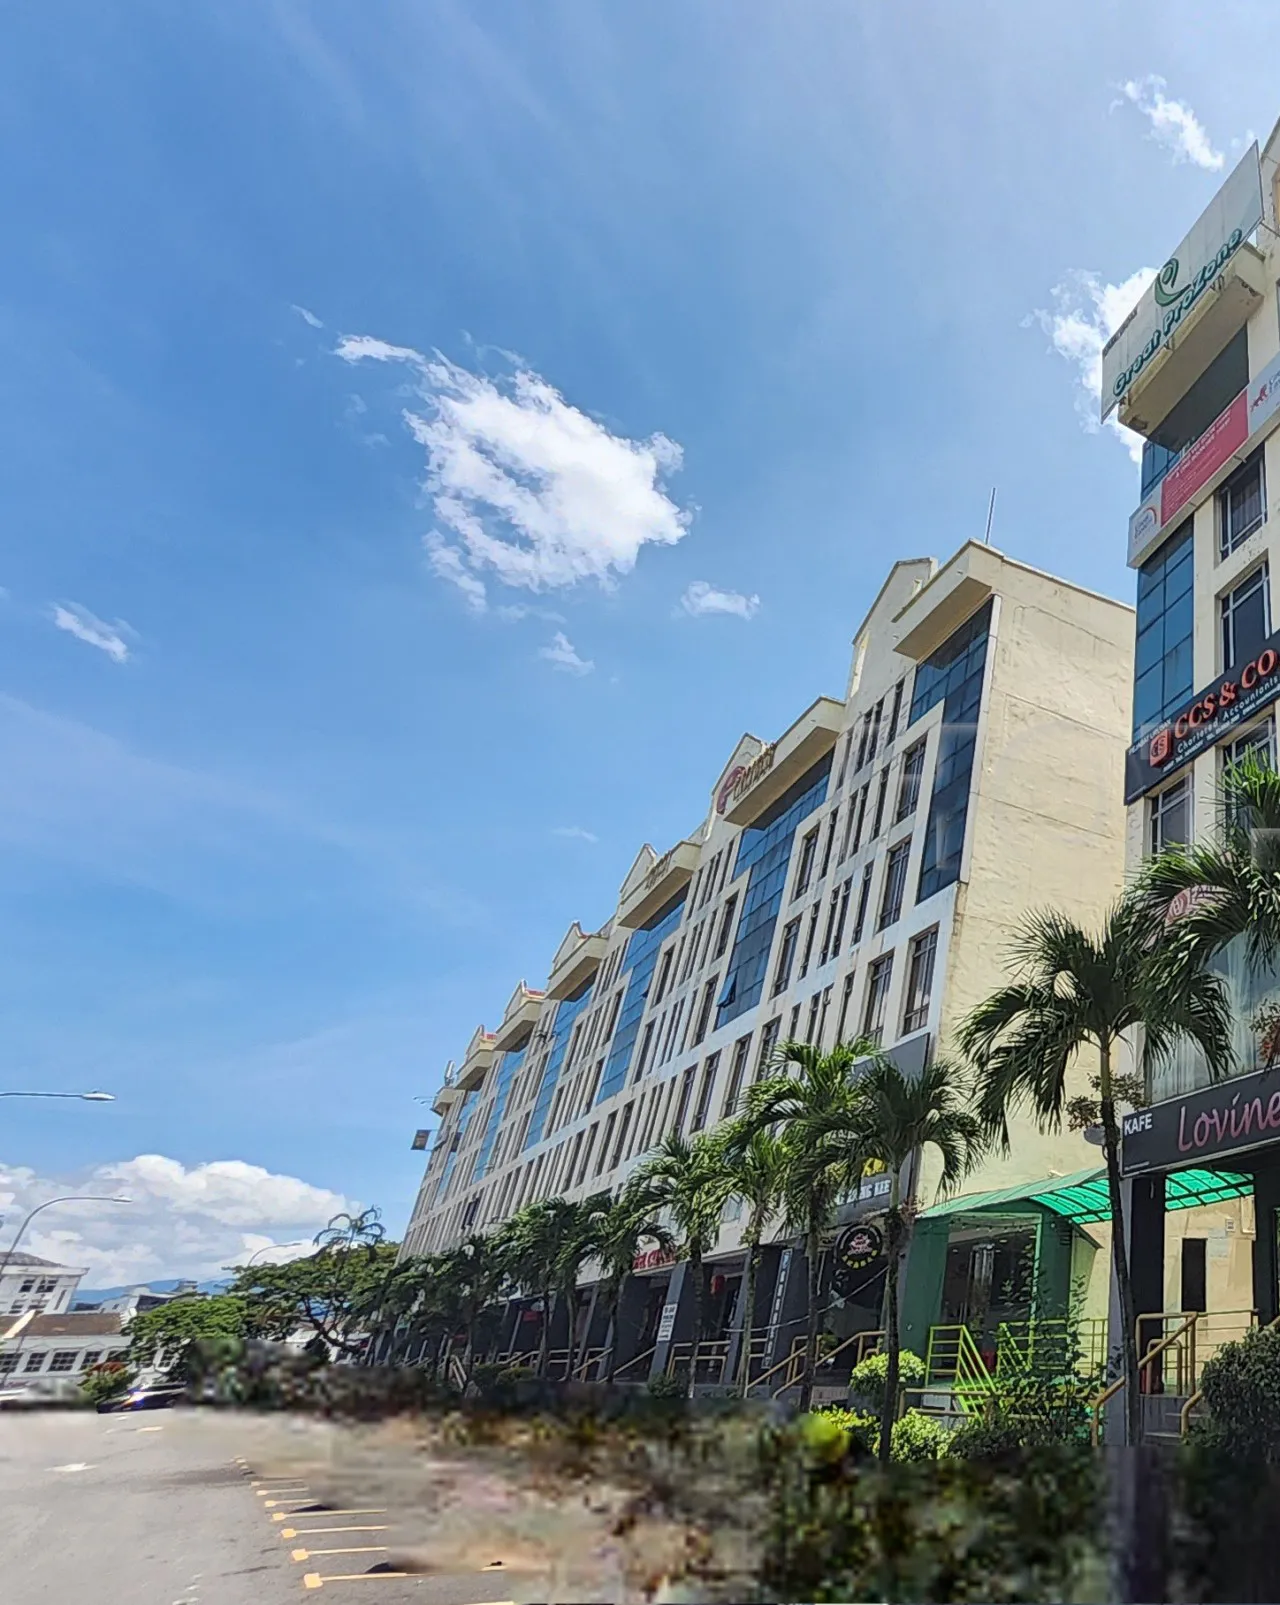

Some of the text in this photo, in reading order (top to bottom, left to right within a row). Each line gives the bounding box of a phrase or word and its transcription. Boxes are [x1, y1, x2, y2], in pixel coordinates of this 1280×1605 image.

[1174, 692, 1216, 739] CCS
[1218, 680, 1238, 706] &
[1241, 648, 1279, 690] CO
[1123, 1113, 1153, 1136] KAFE
